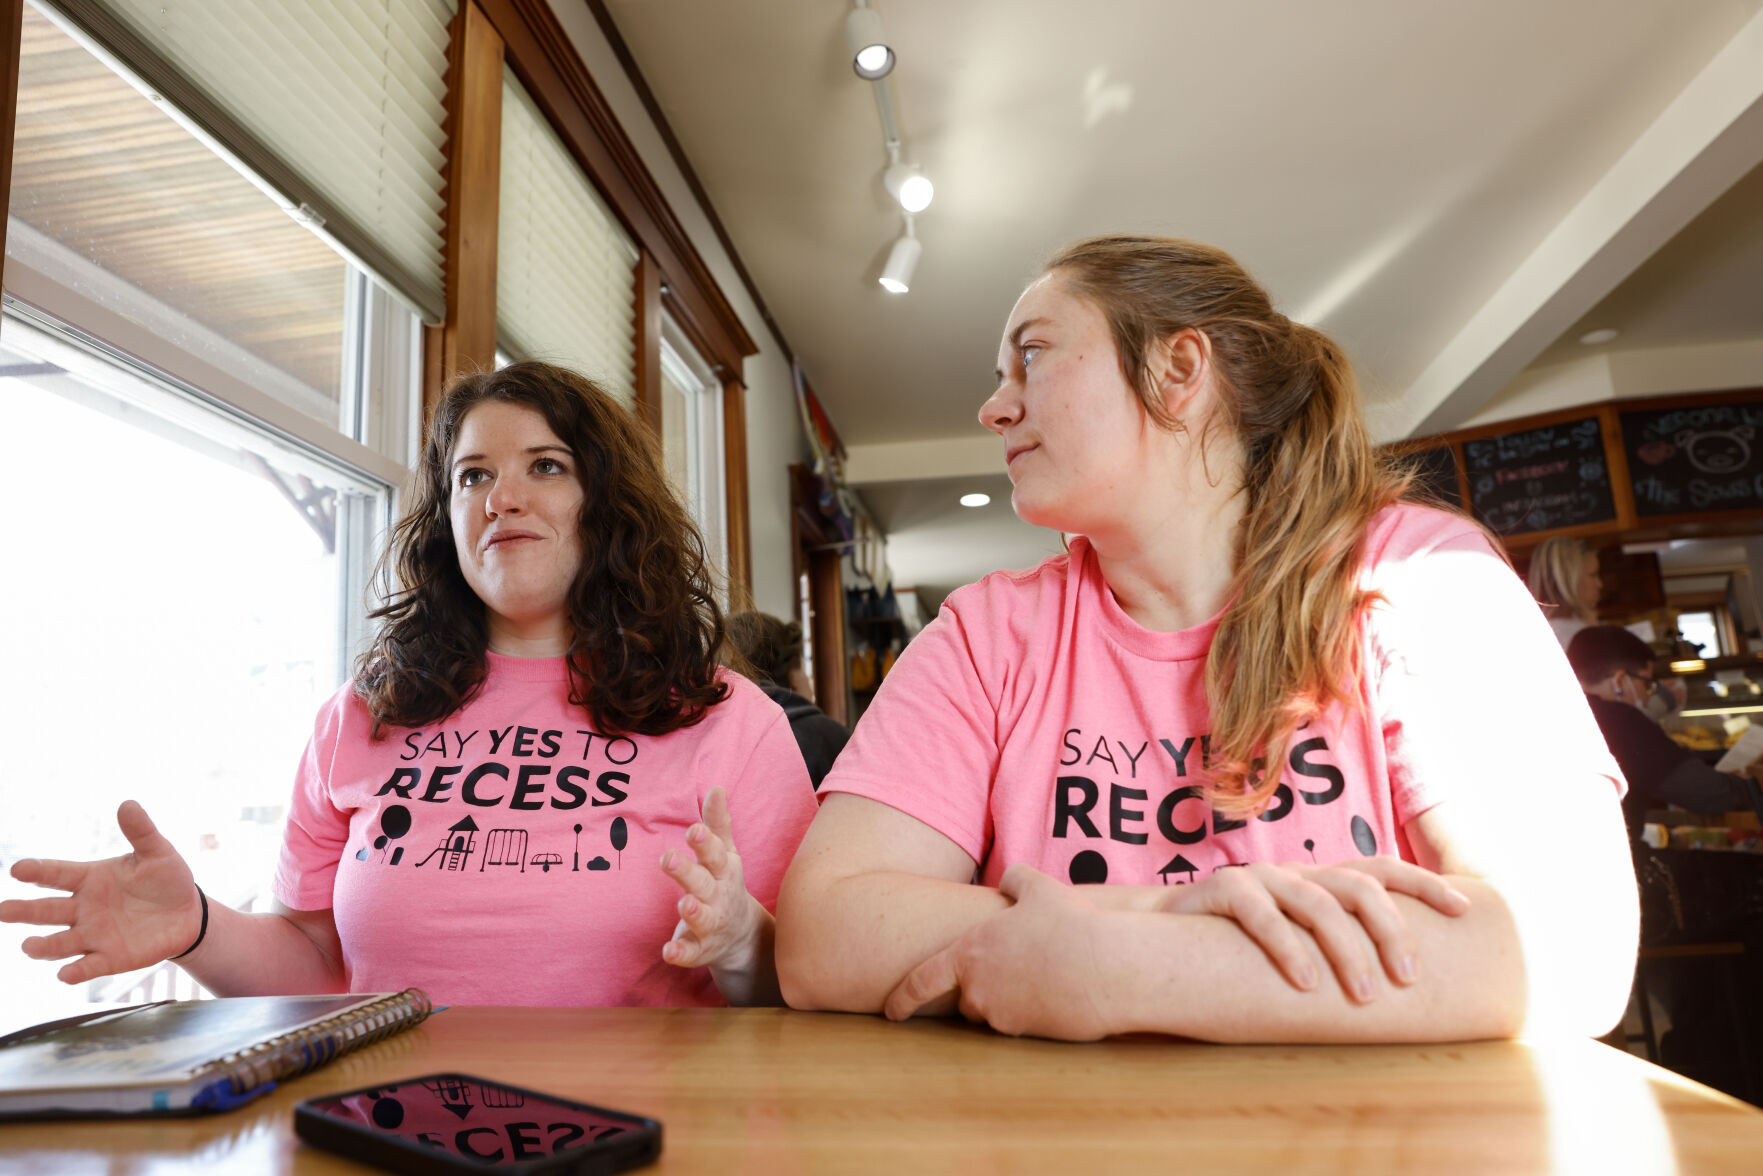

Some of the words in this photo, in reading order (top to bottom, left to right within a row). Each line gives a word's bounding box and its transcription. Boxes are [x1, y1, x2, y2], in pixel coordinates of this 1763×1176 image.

[400, 730, 479, 760] SAY
[488, 725, 563, 758] YES
[576, 730, 638, 765] TO
[1060, 728, 1149, 778] SAY
[373, 762, 631, 810] RECESS
[1052, 737, 1345, 845] RECSS
